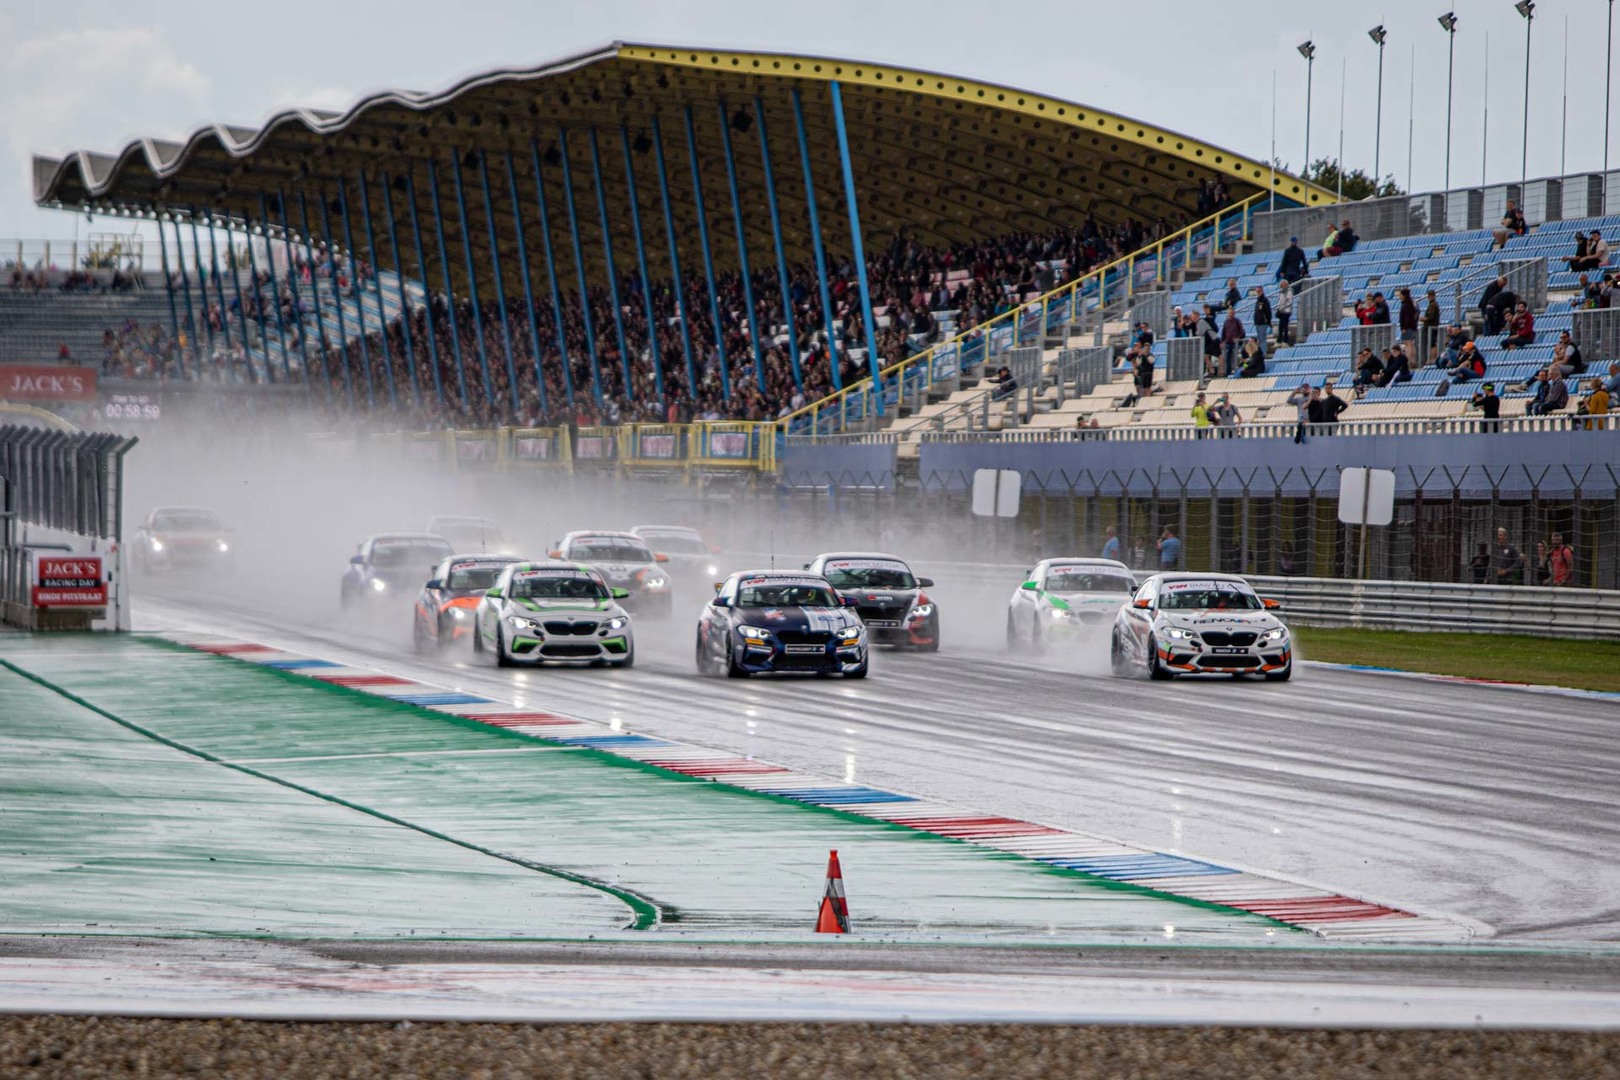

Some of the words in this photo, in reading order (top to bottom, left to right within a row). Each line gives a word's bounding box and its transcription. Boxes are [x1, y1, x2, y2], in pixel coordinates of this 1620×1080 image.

[10, 375, 83, 393] JACK'S
[45, 562, 96, 574] JACK'S
[45, 579, 77, 587] RACING
[79, 579, 95, 587] DAY
[38, 592, 60, 600] EINDE
[62, 592, 103, 600] PITSTRAAT
